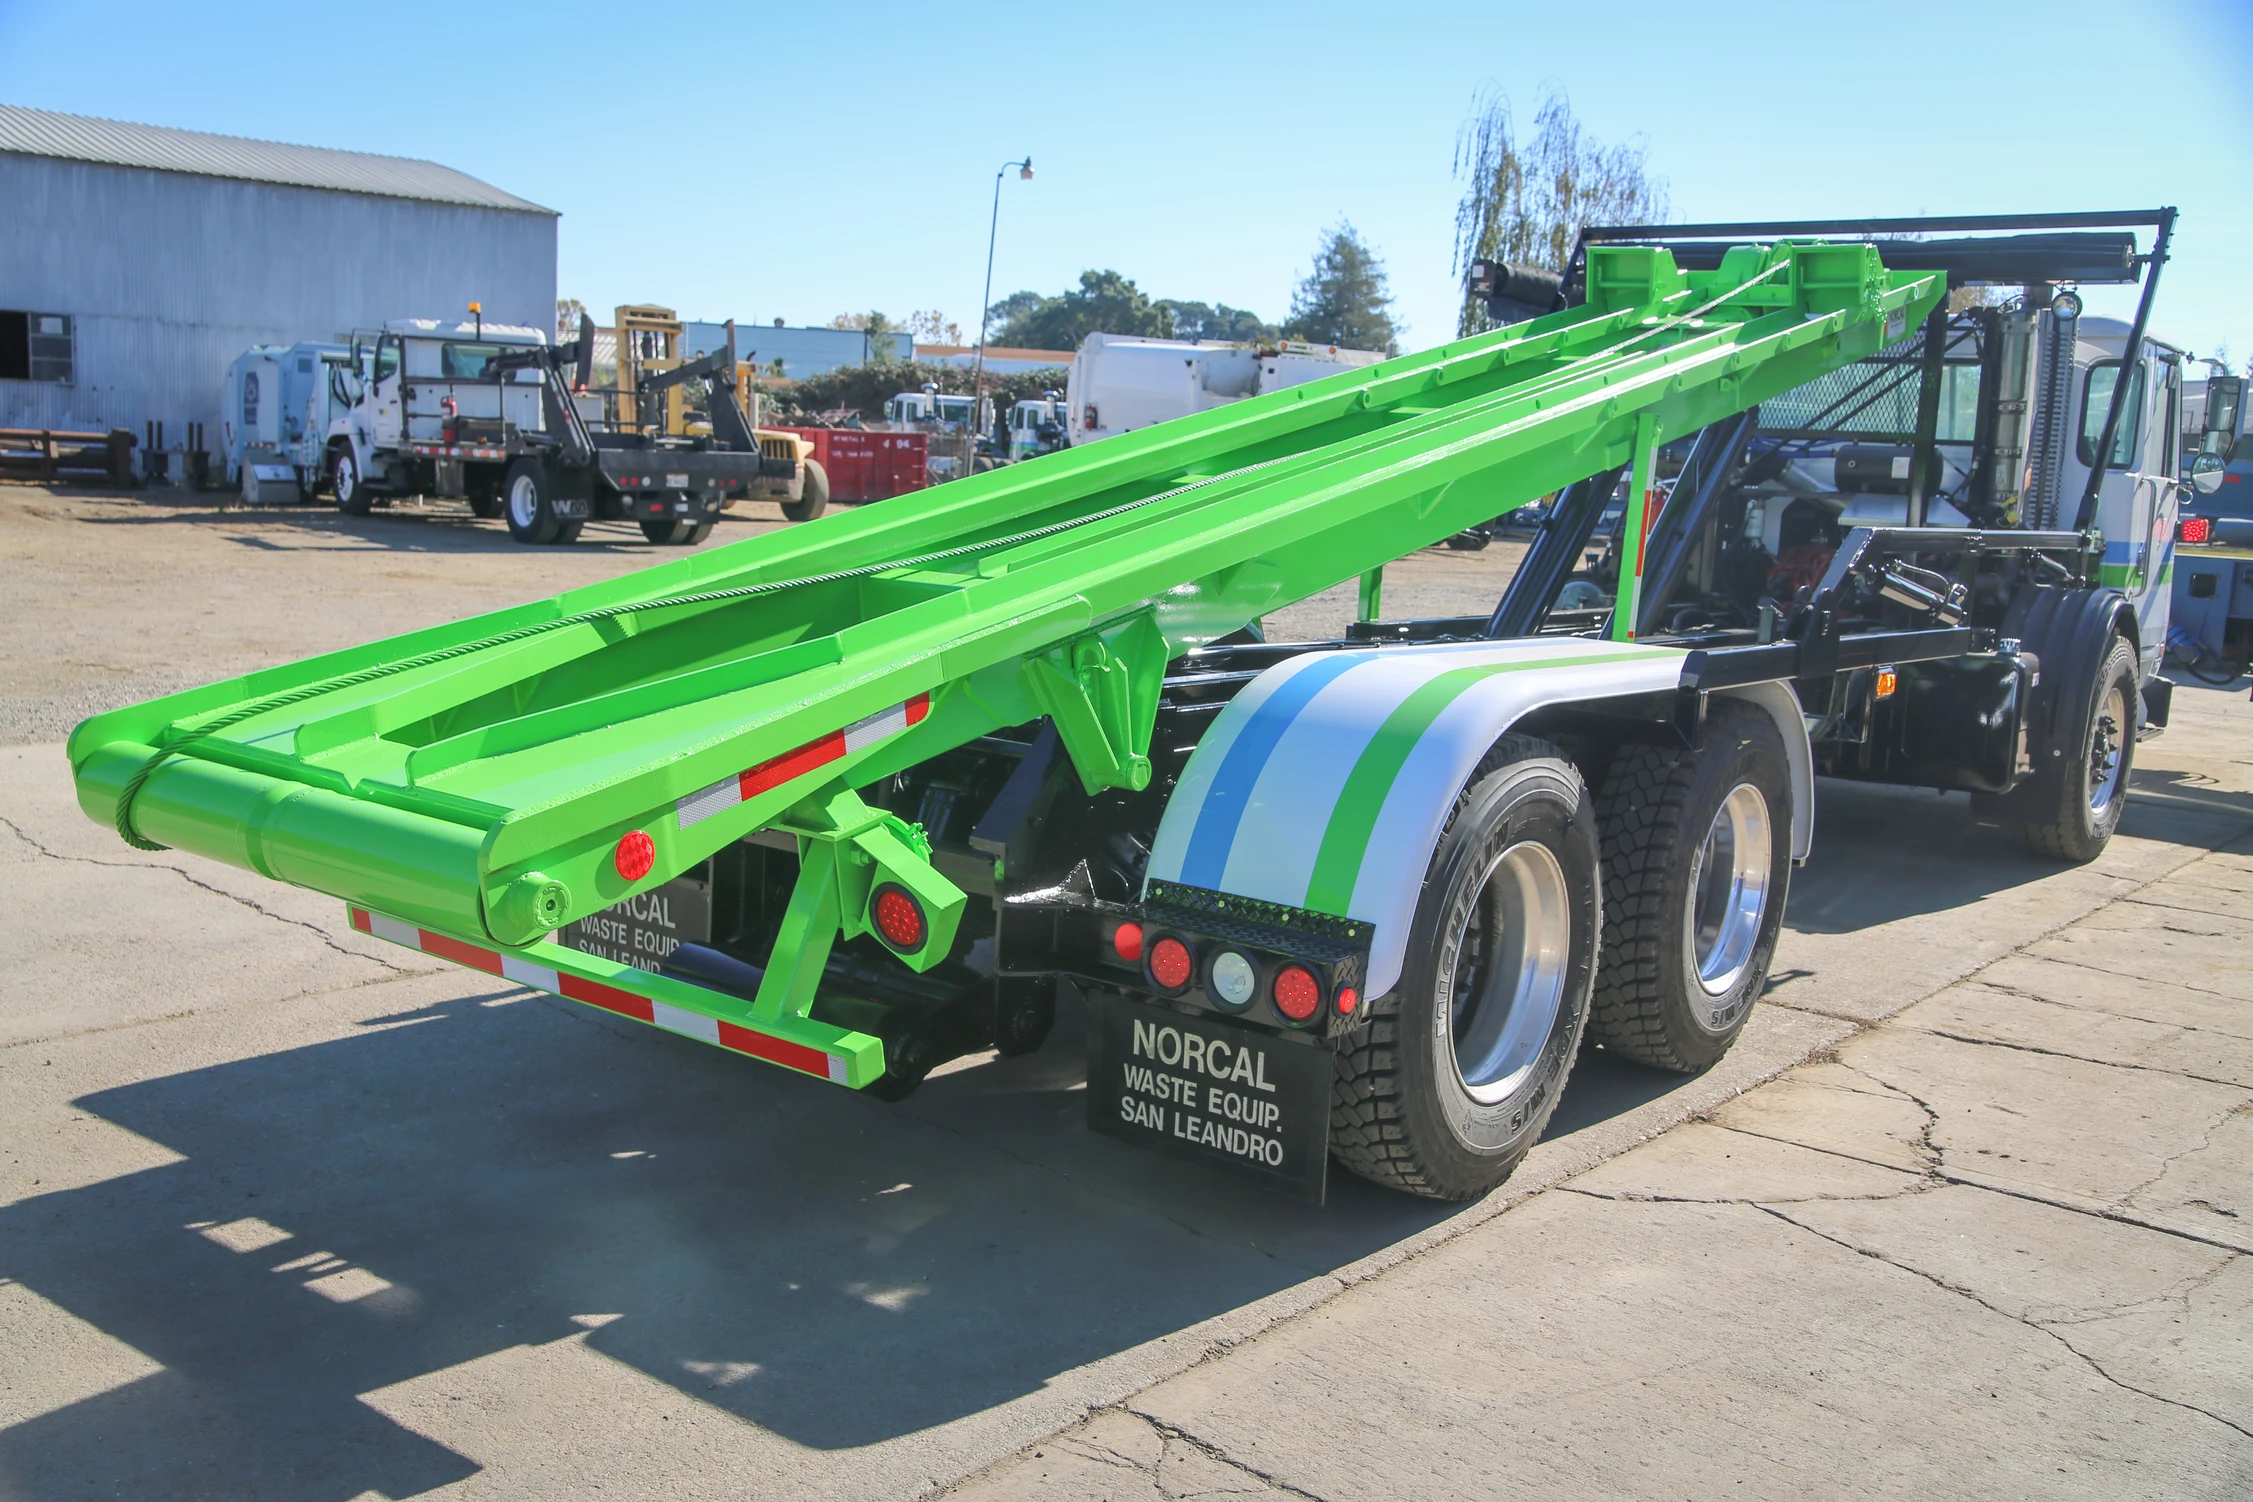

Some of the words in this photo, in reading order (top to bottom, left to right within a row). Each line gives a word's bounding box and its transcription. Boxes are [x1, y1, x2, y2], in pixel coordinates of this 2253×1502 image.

[551, 499, 588, 514] WM
[581, 916, 627, 944] WASTE
[605, 892, 675, 928] RCAL
[1133, 1019, 1275, 1092] NORCAL
[1123, 1062, 1197, 1109] WASTE
[1208, 1087, 1283, 1133] EQUIP.
[1510, 1083, 1546, 1136] M/S
[1120, 1095, 1164, 1132] SAN
[1173, 1112, 1284, 1167] LEANDRO
